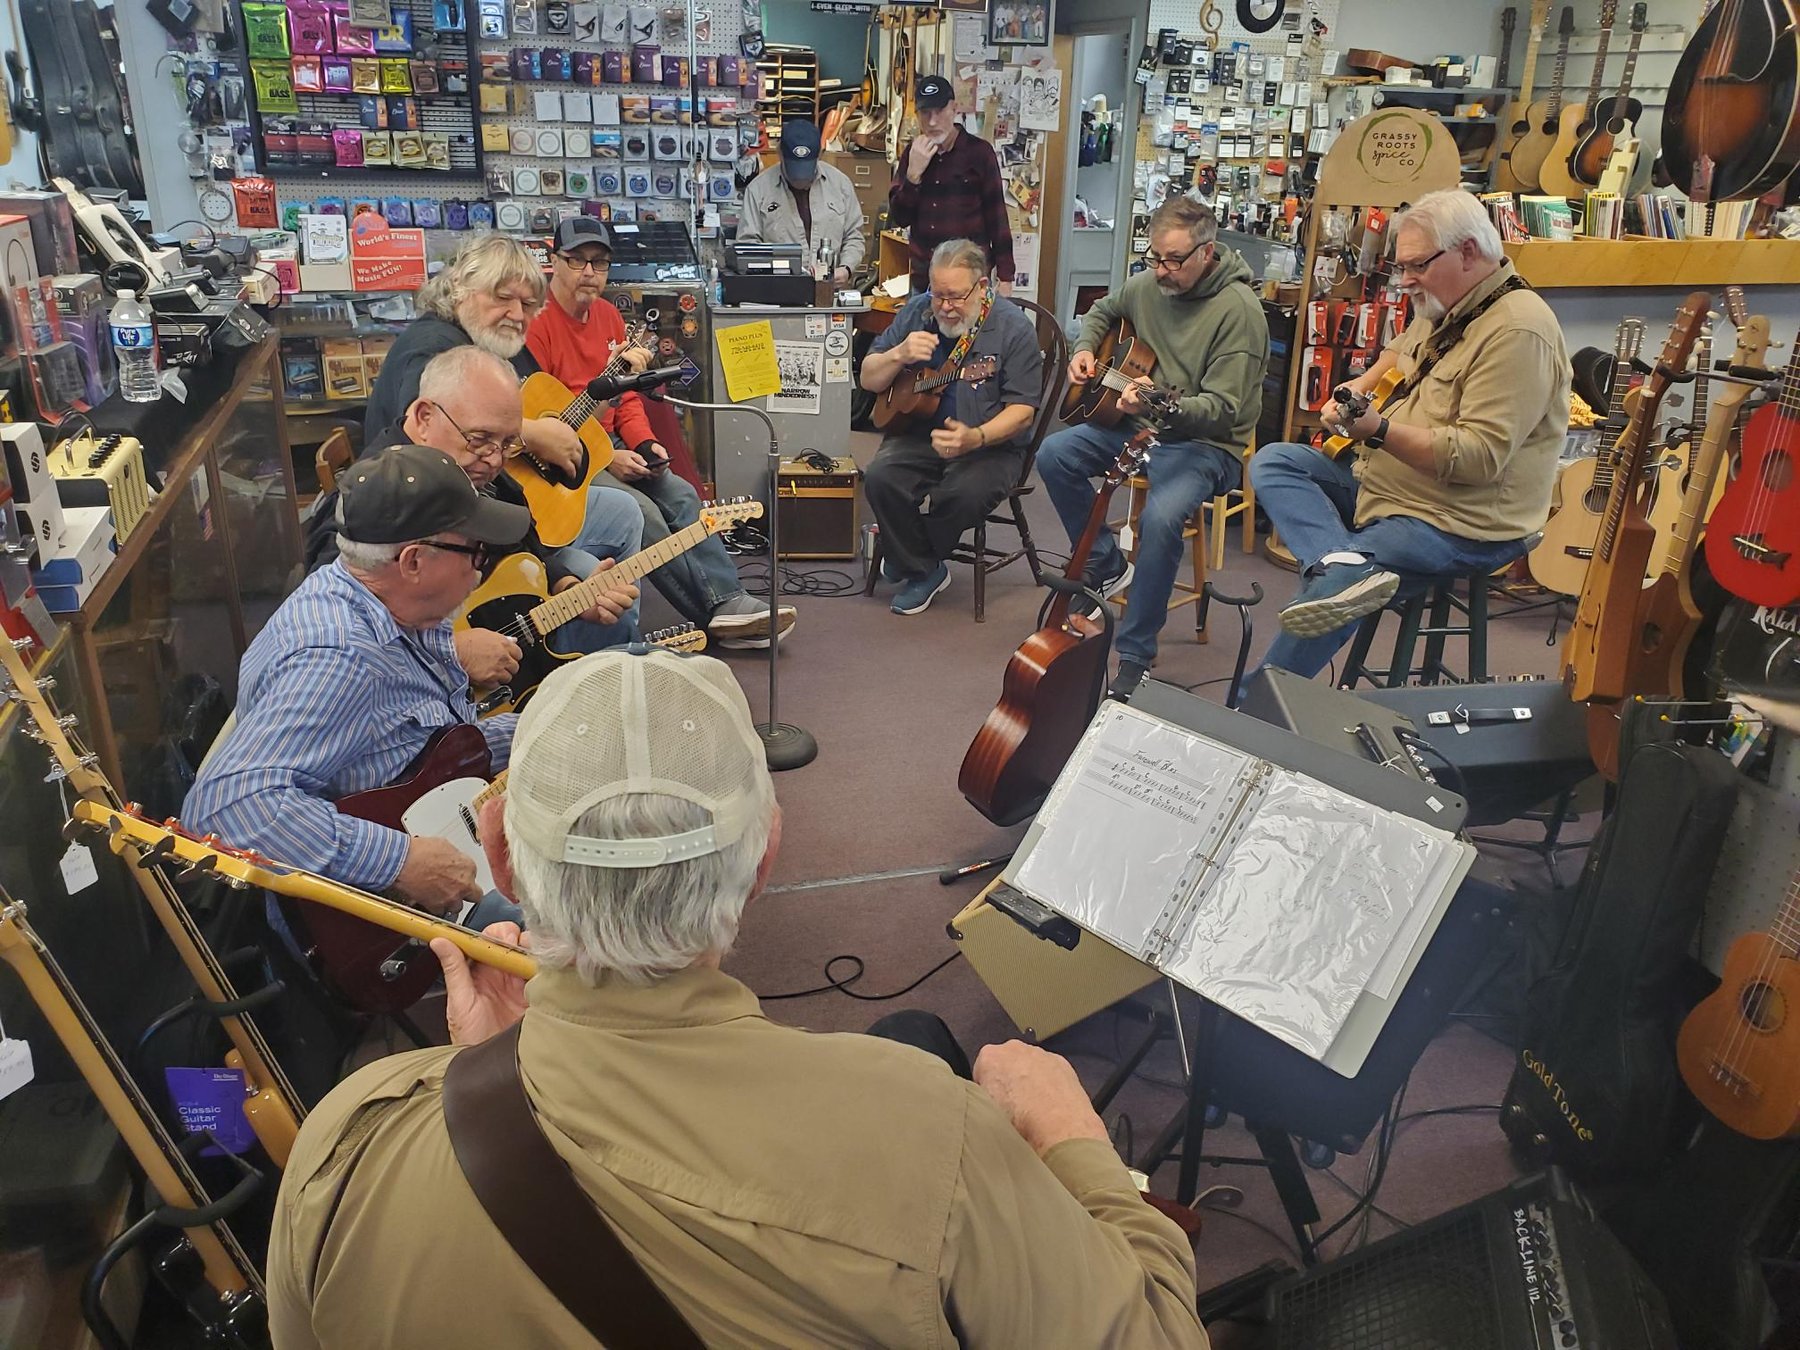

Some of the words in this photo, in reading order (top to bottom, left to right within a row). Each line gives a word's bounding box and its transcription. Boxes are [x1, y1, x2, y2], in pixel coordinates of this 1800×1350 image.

[269, 88, 290, 98] BASS
[1372, 132, 1418, 140] GRASSY
[1376, 141, 1416, 149] ROOTS
[357, 233, 390, 248] World's
[390, 232, 418, 242] Finest
[356, 267, 370, 275] We
[371, 260, 392, 272] Make
[357, 272, 381, 283] Music
[382, 265, 402, 278] FUN!
[1522, 1049, 1554, 1090] Gold
[1551, 1081, 1587, 1141] Tone
[178, 1105, 222, 1115] Classic
[1513, 1207, 1538, 1285] BACKLINE
[1527, 1285, 1541, 1306] 112
